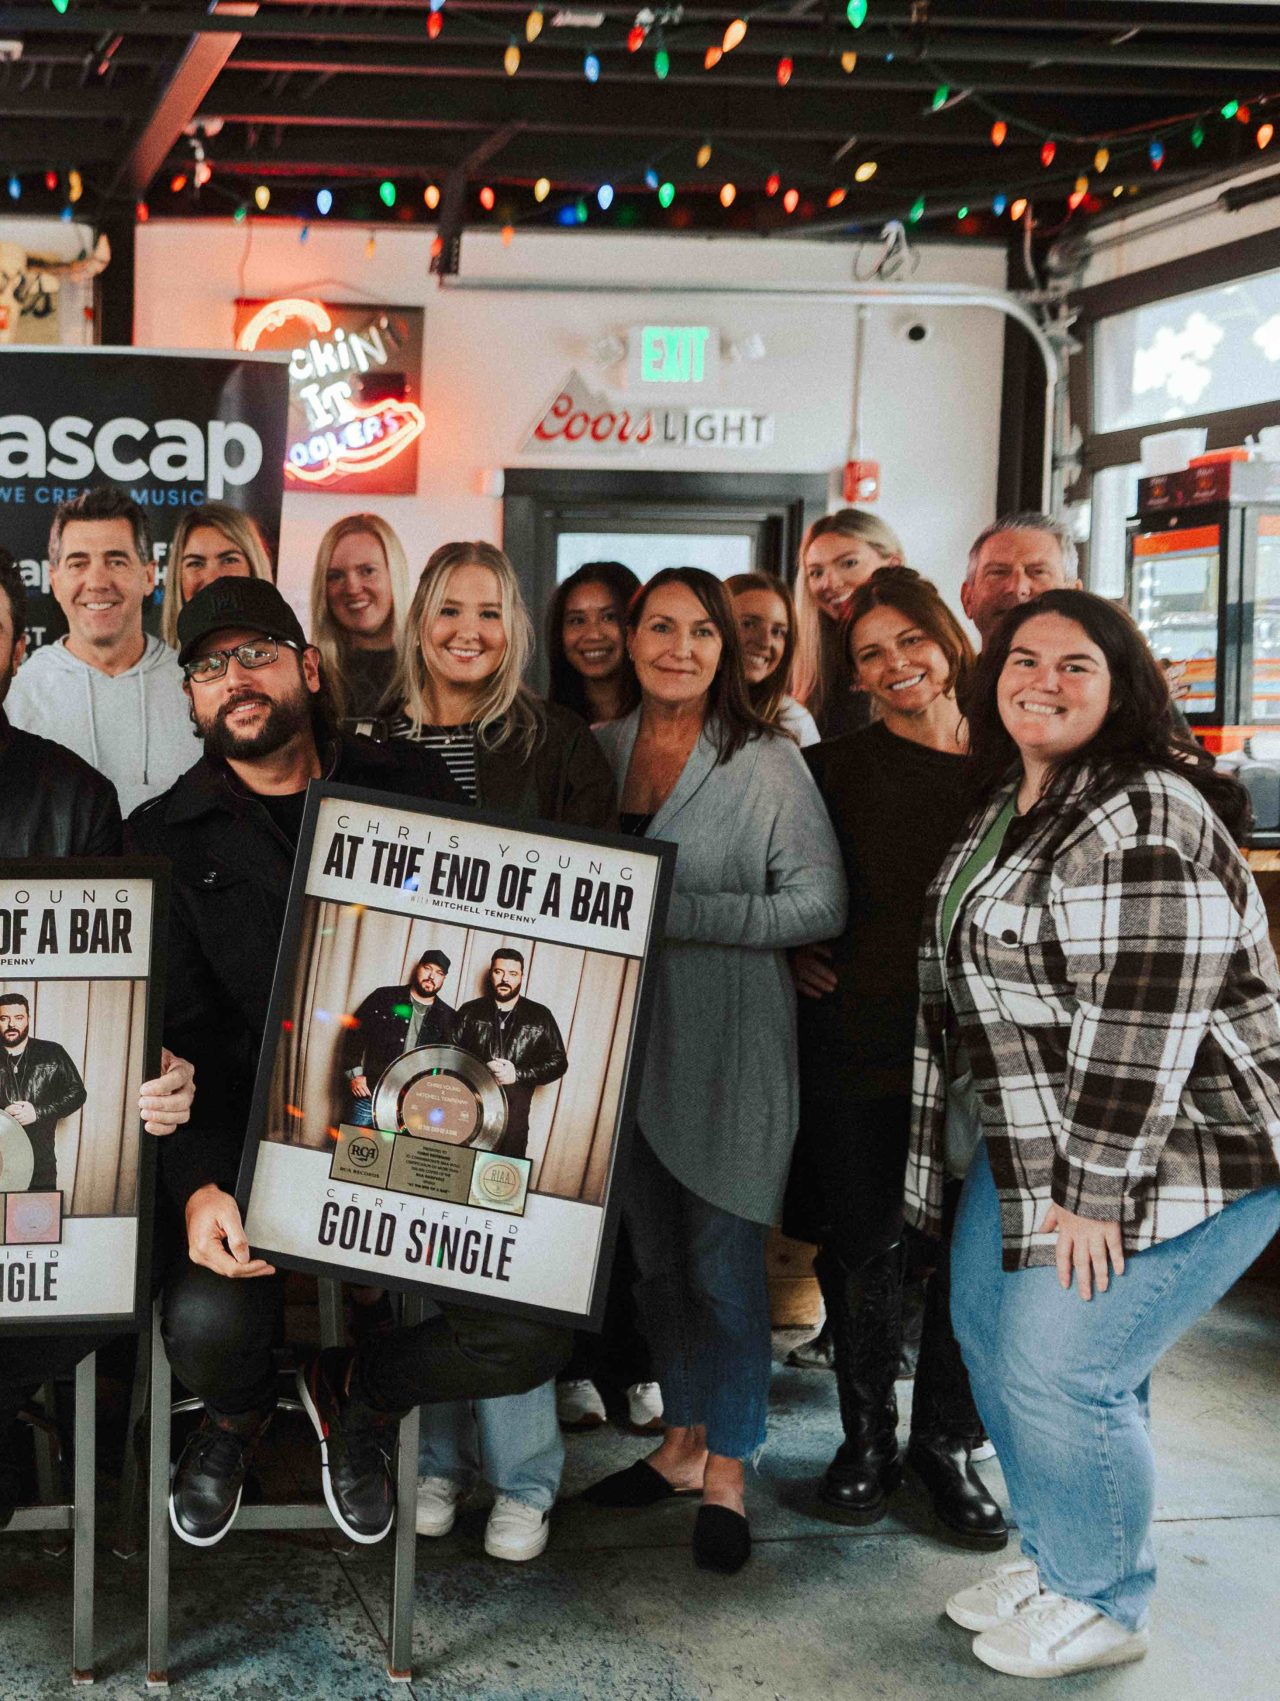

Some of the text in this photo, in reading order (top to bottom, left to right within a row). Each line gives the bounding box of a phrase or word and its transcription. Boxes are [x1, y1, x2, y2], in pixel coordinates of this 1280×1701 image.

[642, 326, 709, 382] EXIT
[534, 395, 767, 443] Coors LIGHT
[35, 487, 89, 503] CRE
[130, 489, 206, 506] MUSIC
[337, 815, 633, 881] CHRIS YOUNG
[322, 832, 634, 931] AT THE END OF A BAR
[37, 908, 58, 954] A
[69, 907, 132, 954] BAR
[432, 899, 481, 915] MITCHELL
[484, 907, 537, 925] TENPENNY
[351, 1144, 376, 1161] RCA
[327, 1188, 518, 1235] CERTIFIED
[317, 1201, 516, 1282] GOLD SINGLE
